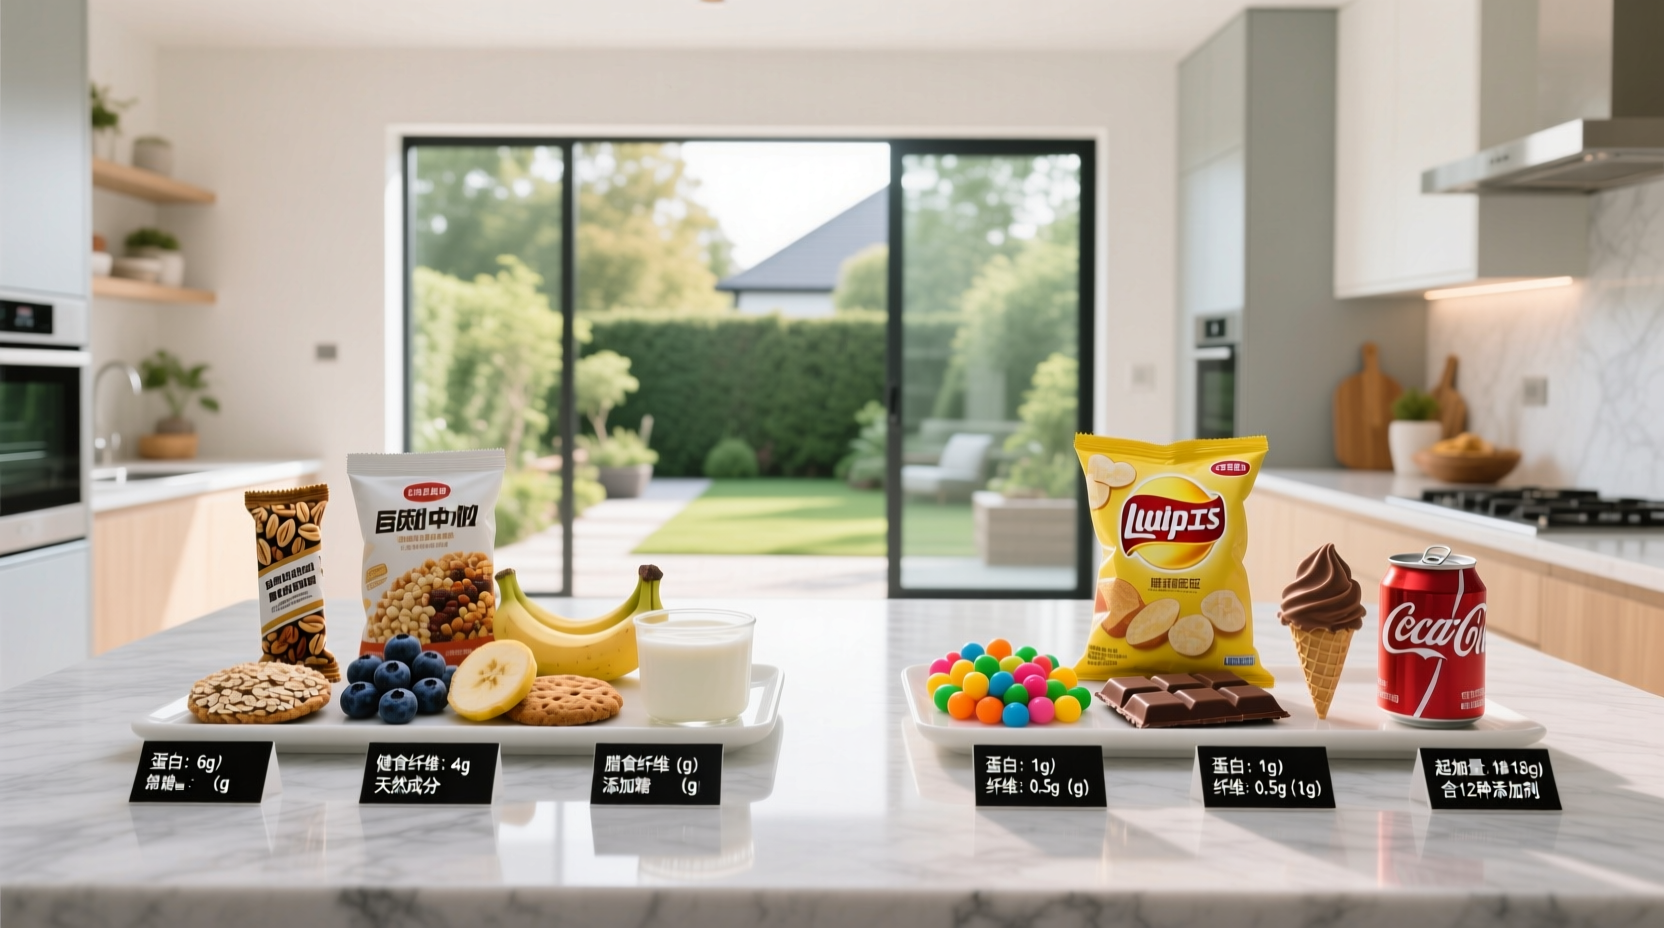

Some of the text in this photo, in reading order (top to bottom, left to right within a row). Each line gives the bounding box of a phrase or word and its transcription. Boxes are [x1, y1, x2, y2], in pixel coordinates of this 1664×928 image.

[197, 754, 223, 773] 6g)
[450, 757, 471, 776] 4g
[676, 757, 699, 775] (g)
[1031, 757, 1056, 776] 1g)
[1259, 759, 1284, 777] 1g)
[374, 775, 442, 796] 天然成分
[1029, 778, 1060, 797] 0.5g
[1067, 778, 1090, 798] (g)
[1254, 779, 1287, 798] 0.5g
[1291, 778, 1322, 799] (1g)
